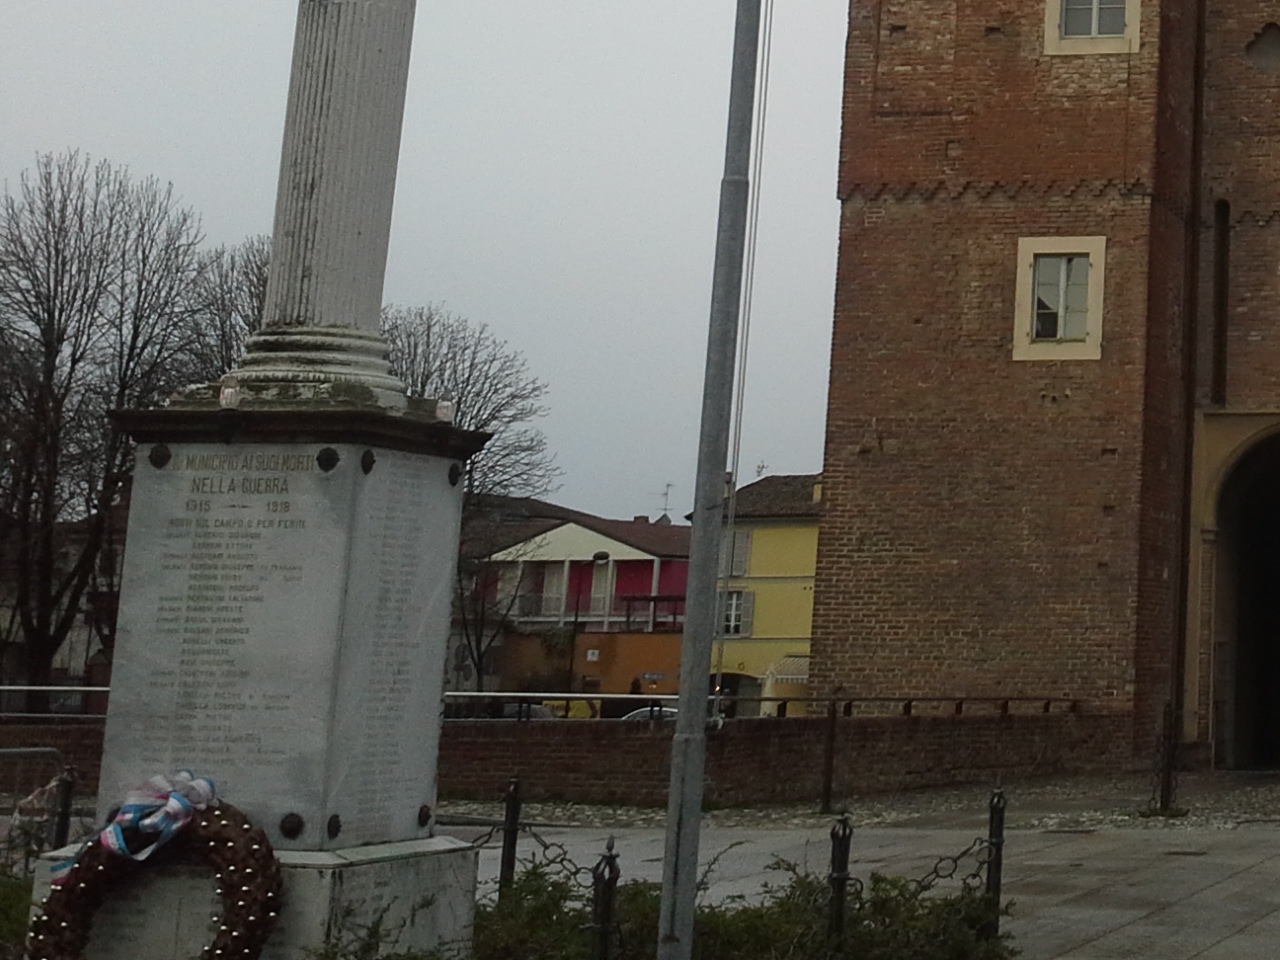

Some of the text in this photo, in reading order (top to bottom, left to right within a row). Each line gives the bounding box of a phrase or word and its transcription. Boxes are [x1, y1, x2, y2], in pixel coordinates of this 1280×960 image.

[186, 454, 238, 471] MUNICIPIO
[191, 477, 289, 494] NELLA GUERRA
[186, 499, 291, 513] 1915 1918
